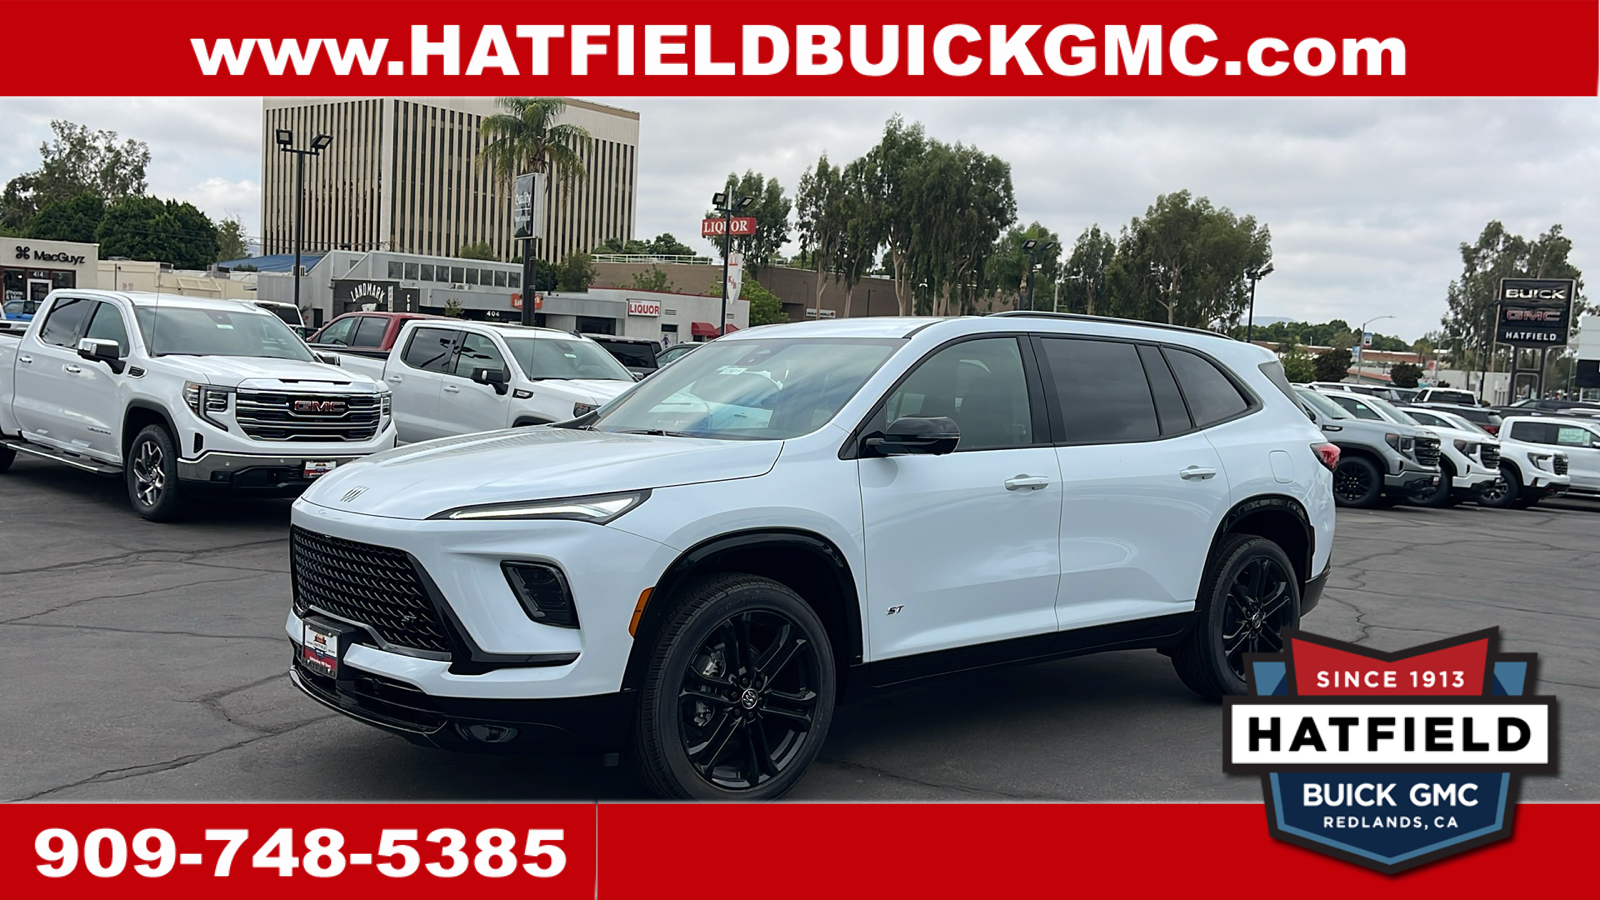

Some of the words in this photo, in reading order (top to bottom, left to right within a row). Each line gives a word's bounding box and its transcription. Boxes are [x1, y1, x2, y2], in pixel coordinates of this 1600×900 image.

[34, 250, 85, 265] MacGuyz
[350, 282, 386, 304] LANDMARK
[1505, 288, 1566, 299] BUICK
[629, 304, 660, 315] LIQUOR
[1506, 310, 1561, 321] GMC
[1505, 332, 1557, 341] HATFIELD
[294, 400, 346, 412] GMC
[886, 604, 905, 616] ST
